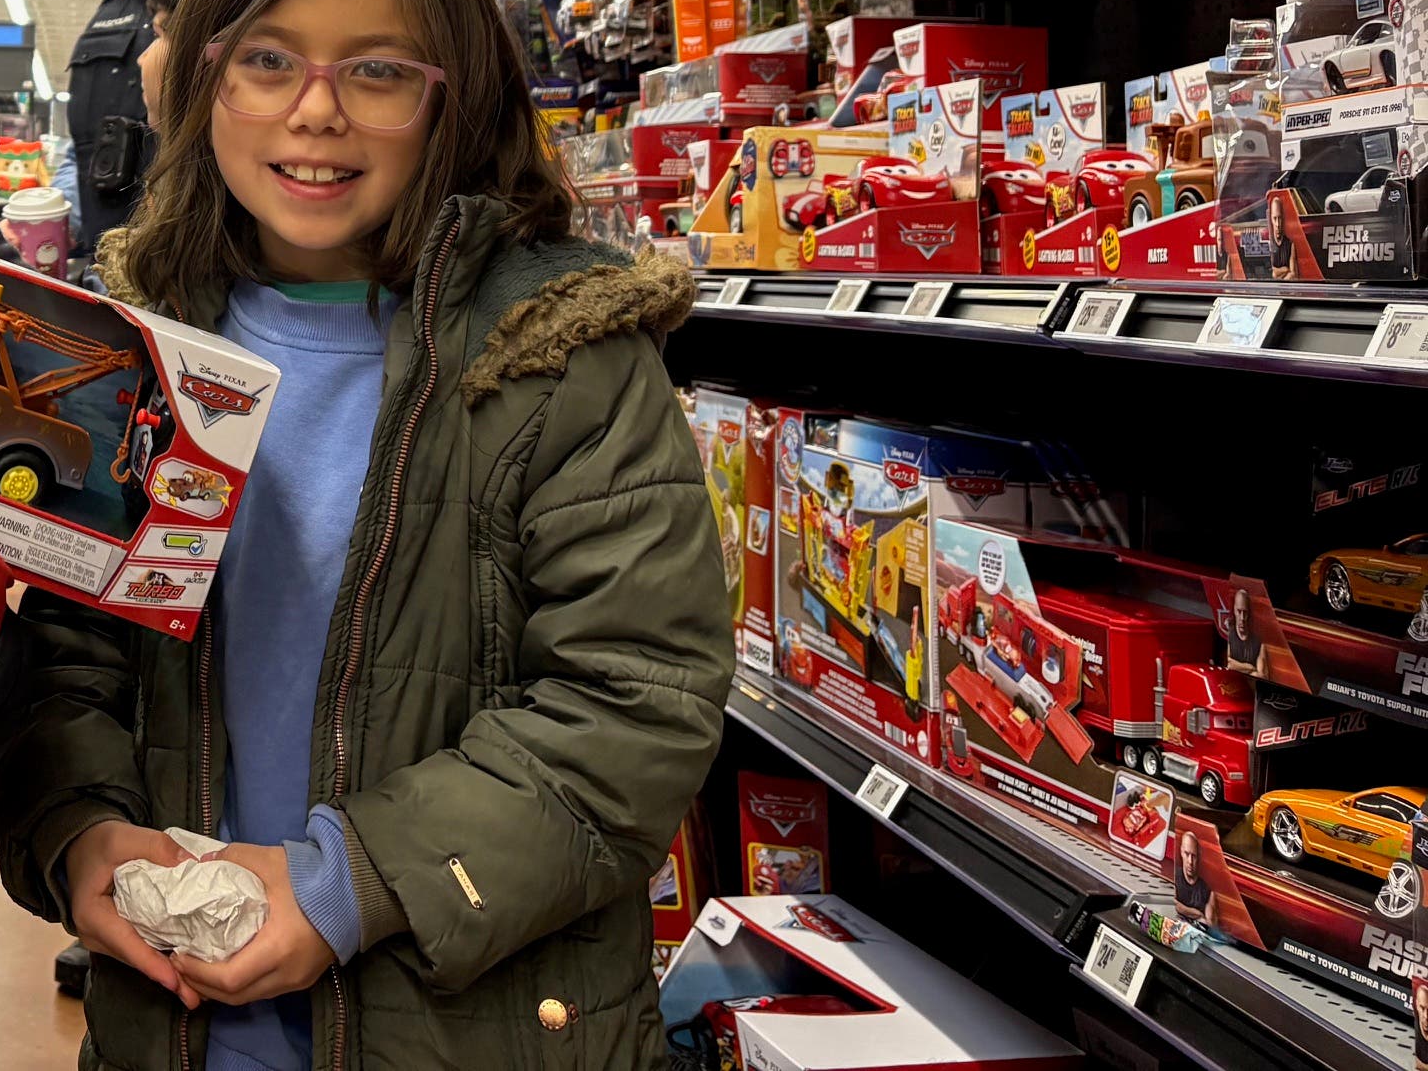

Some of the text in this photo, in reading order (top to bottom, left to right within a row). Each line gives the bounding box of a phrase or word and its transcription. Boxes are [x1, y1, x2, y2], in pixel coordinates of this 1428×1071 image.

[895, 107, 916, 119] TRACK
[1010, 109, 1034, 124] TRACK
[1286, 110, 1331, 129] HYPER-SPEC
[1339, 109, 1361, 119] PORSCHE
[1362, 108, 1370, 117] 911
[1371, 106, 1381, 116] GT3
[1381, 105, 1389, 113] RS
[1323, 224, 1370, 250] FAST &
[1148, 248, 1168, 264] MATER
[1328, 242, 1395, 268] FURIOUS
[198, 363, 248, 387] Disney PIXAR
[186, 380, 244, 409] Cars
[885, 463, 916, 484] Cars
[1314, 474, 1389, 511] ELITE
[124, 582, 186, 601] TURBO
[169, 619, 186, 631] 6+
[1327, 681, 1412, 714] BRIAN'S TOYOTA SUPRA
[1256, 717, 1334, 748] ELITE
[1283, 941, 1316, 964] BRIAN'S
[1317, 955, 1349, 977] TOYOTA
[1350, 968, 1379, 990] SUPRA
[1380, 982, 1408, 1002] NITRO
